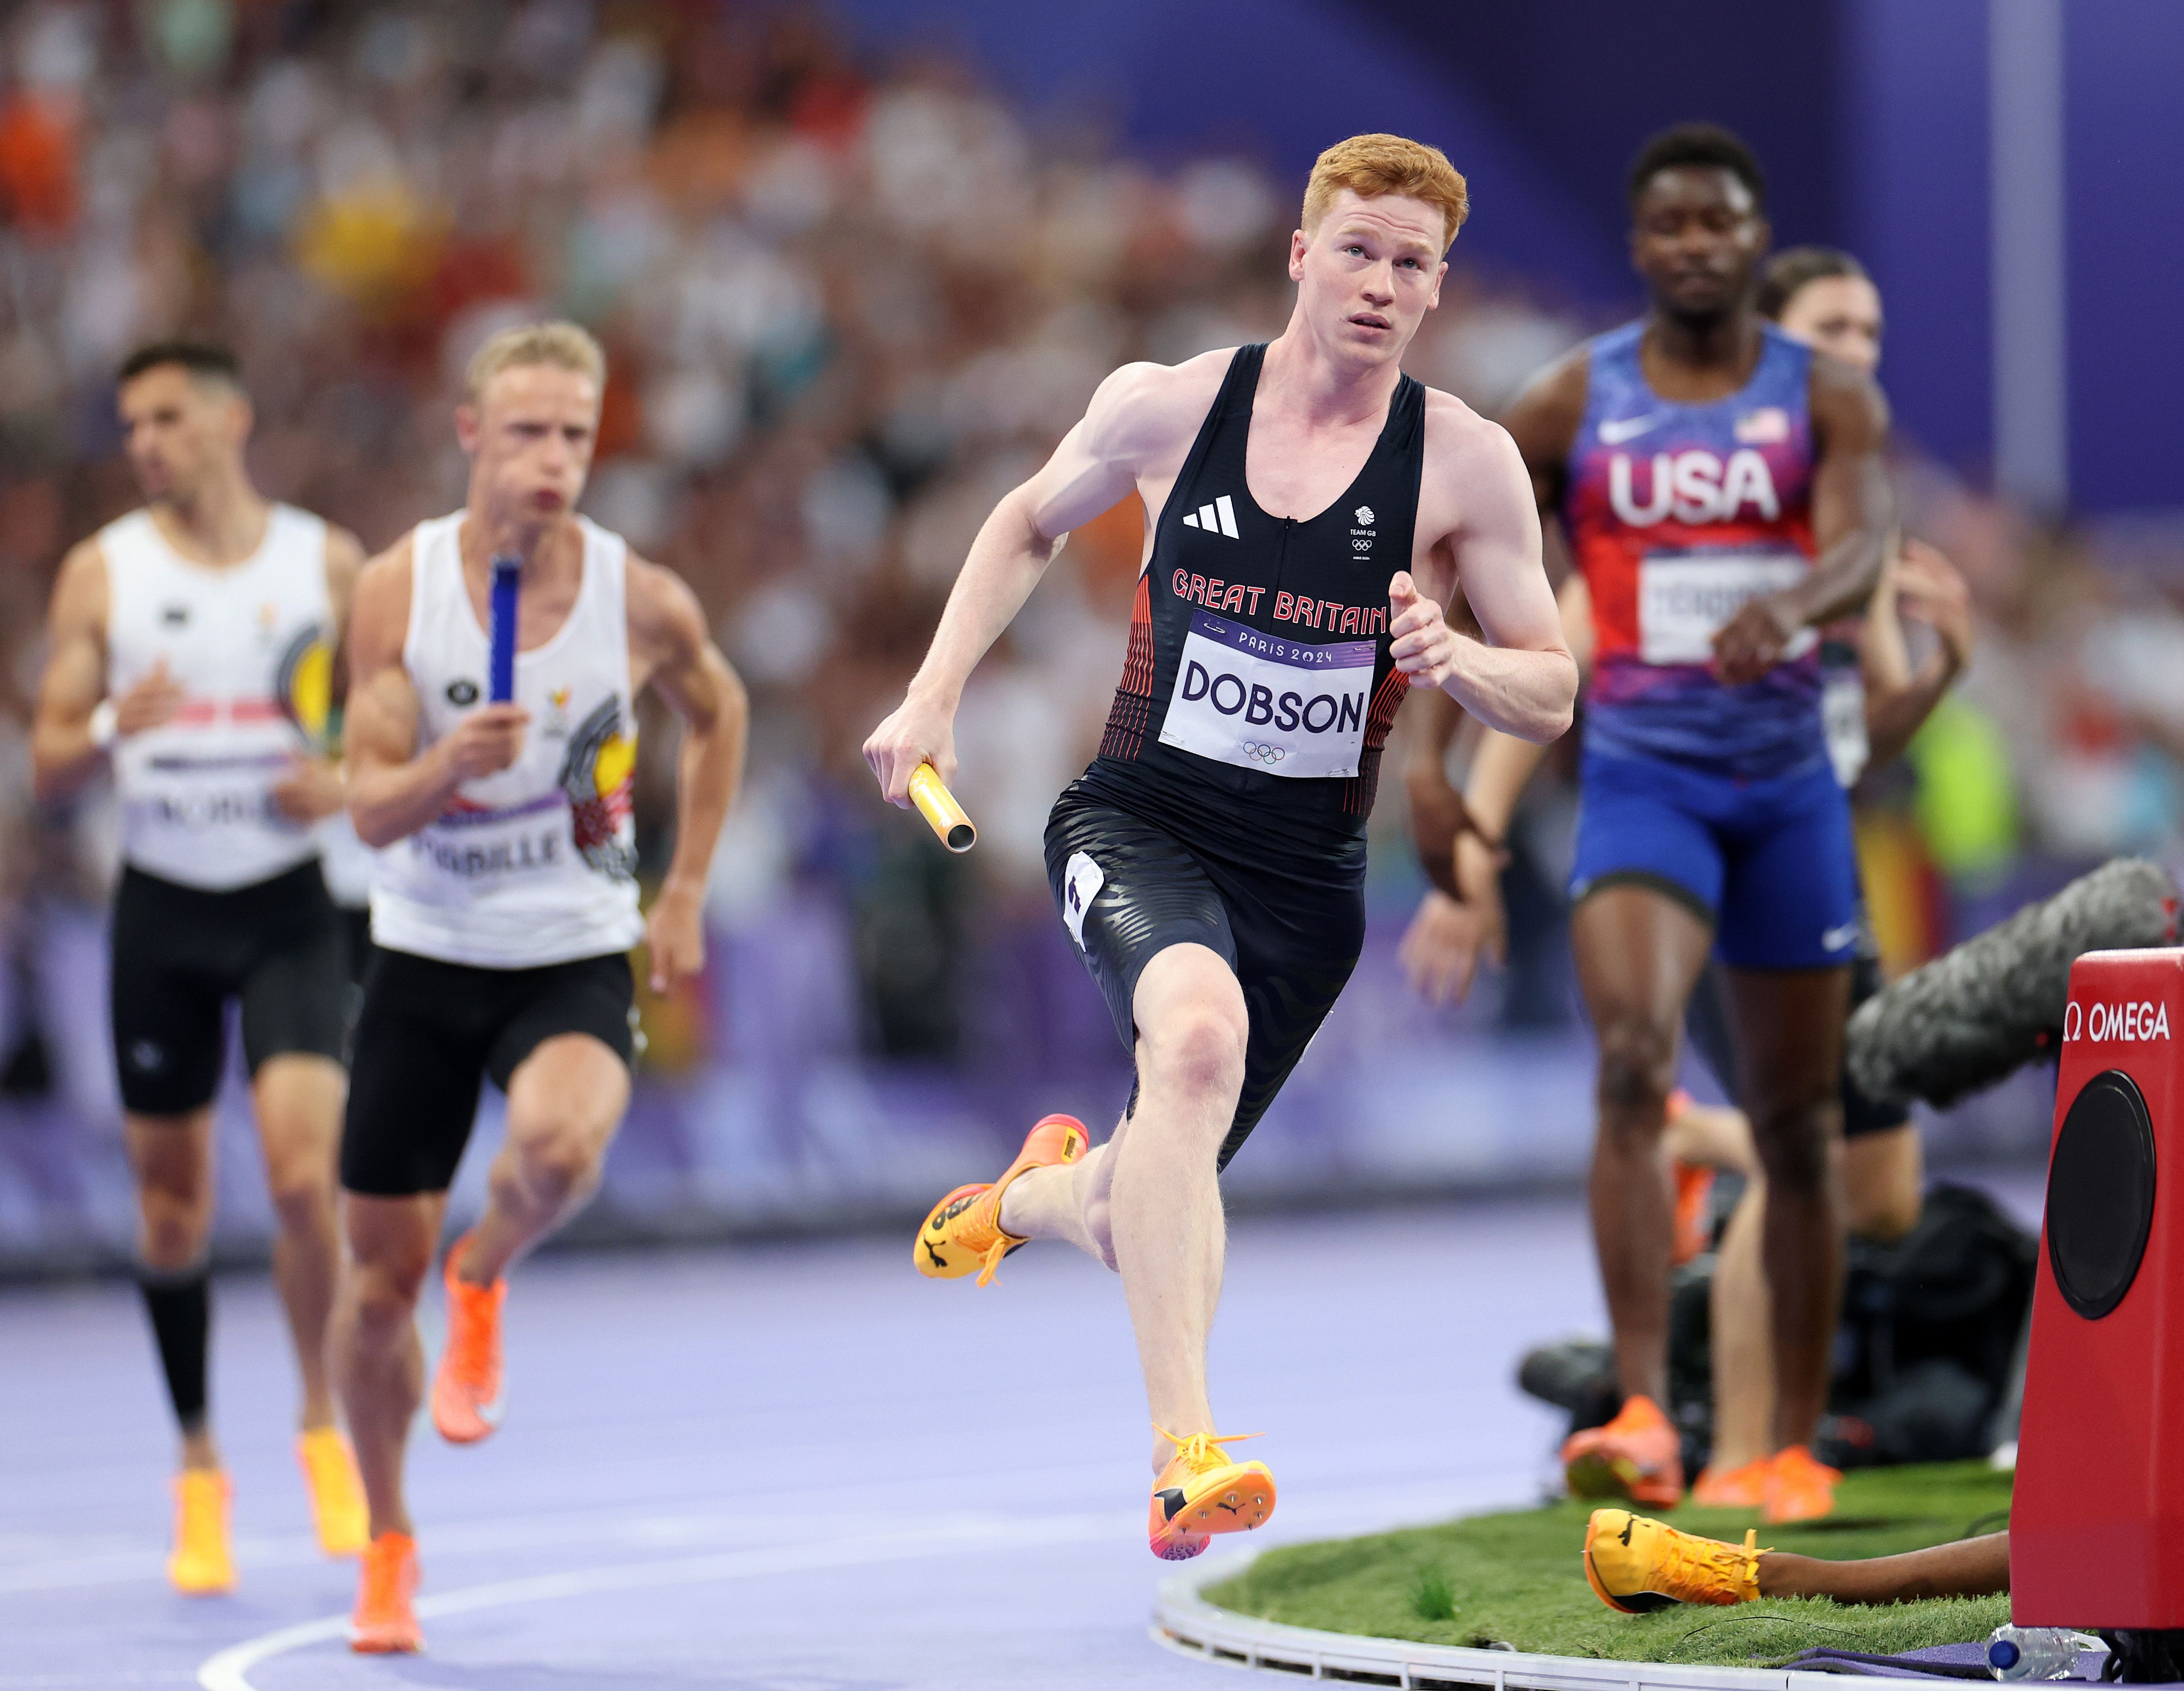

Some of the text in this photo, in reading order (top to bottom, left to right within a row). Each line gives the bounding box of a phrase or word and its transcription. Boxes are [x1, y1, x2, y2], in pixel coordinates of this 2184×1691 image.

[1609, 449, 1780, 527] USA
[1172, 568, 1386, 635] GREAT BRITAIN
[1239, 632, 1332, 663] PARIS 2024
[1182, 660, 1364, 733] DOBSON
[2088, 1000, 2171, 1043] OMEGA
